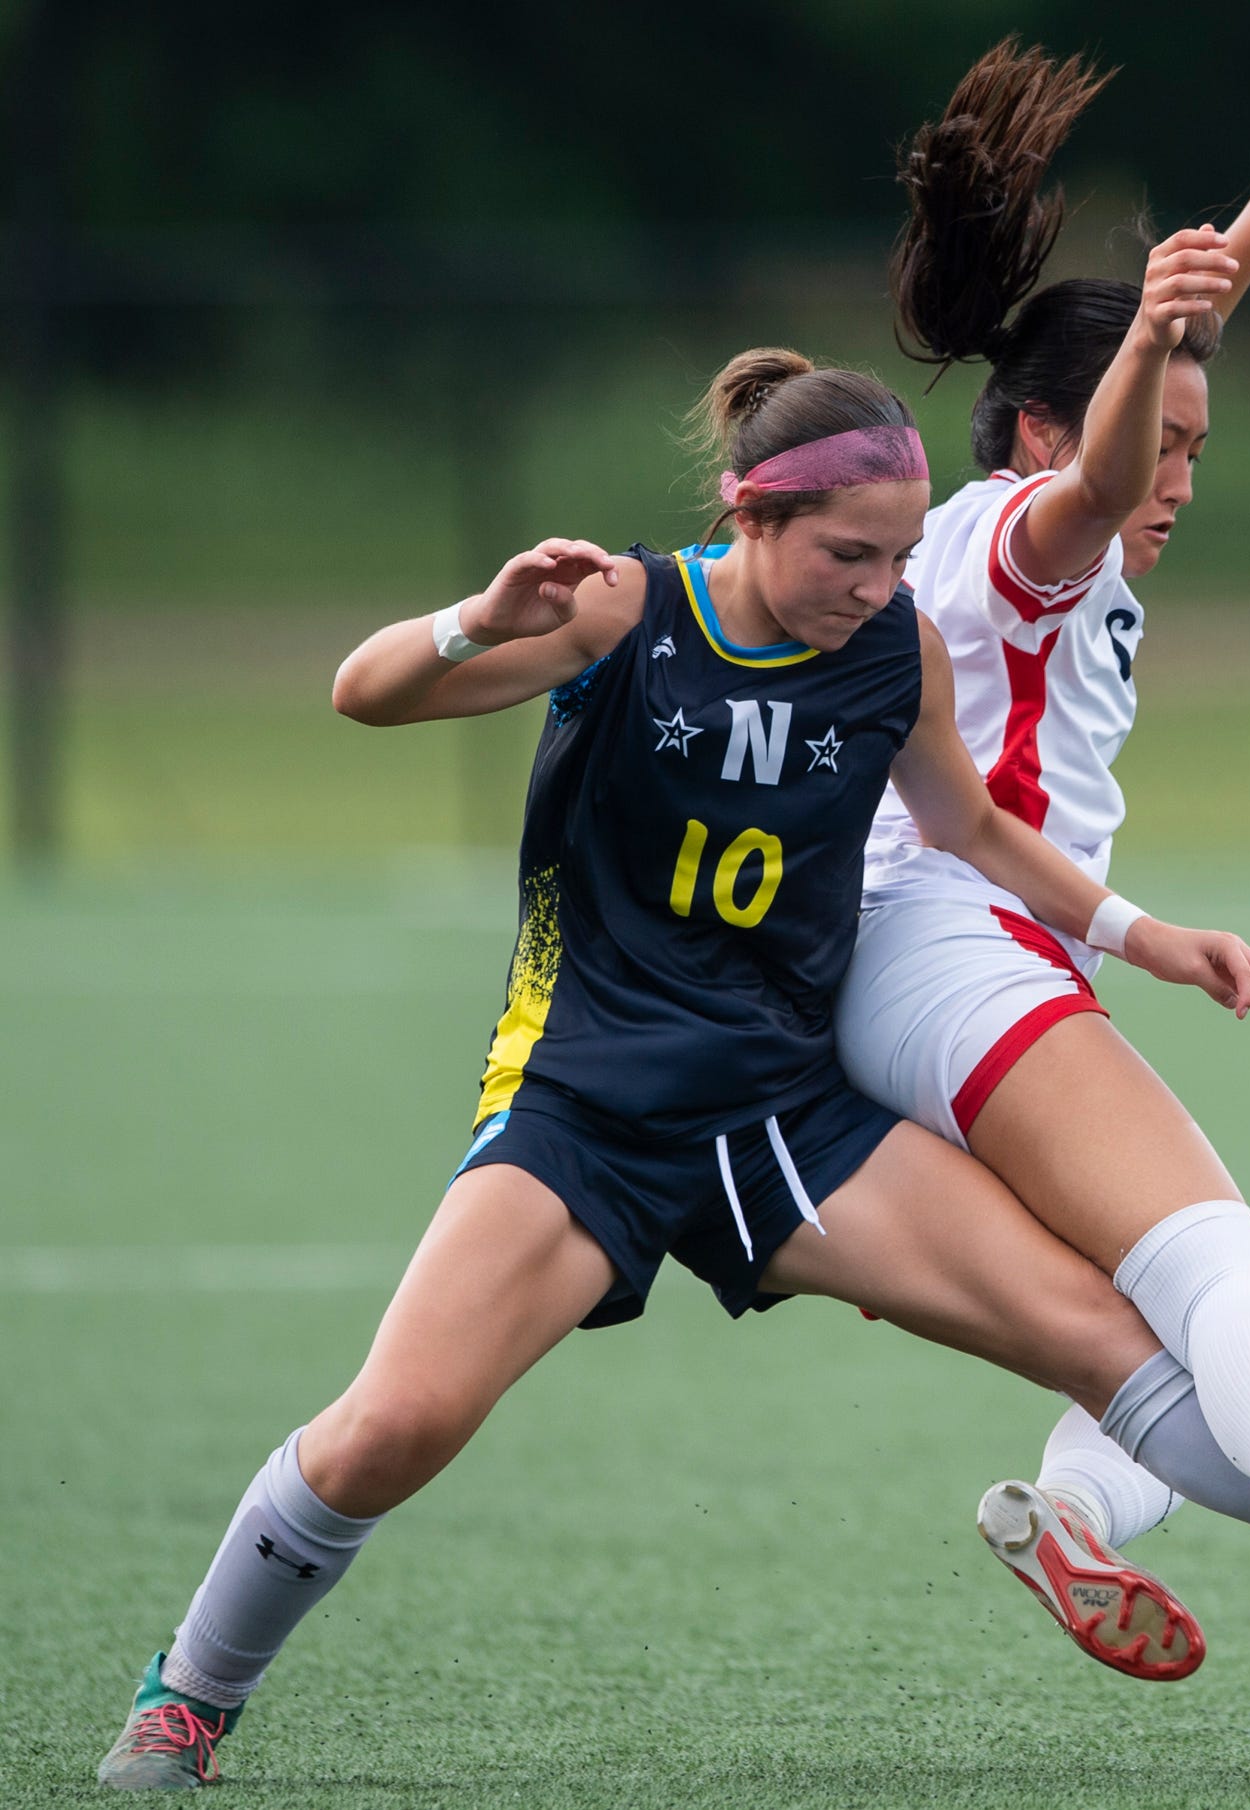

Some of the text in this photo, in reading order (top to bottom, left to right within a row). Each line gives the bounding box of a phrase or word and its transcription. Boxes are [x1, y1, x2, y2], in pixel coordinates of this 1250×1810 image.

[720, 699, 793, 786] N
[669, 818, 784, 929] 10
[1072, 1586, 1119, 1601] ZOOM
